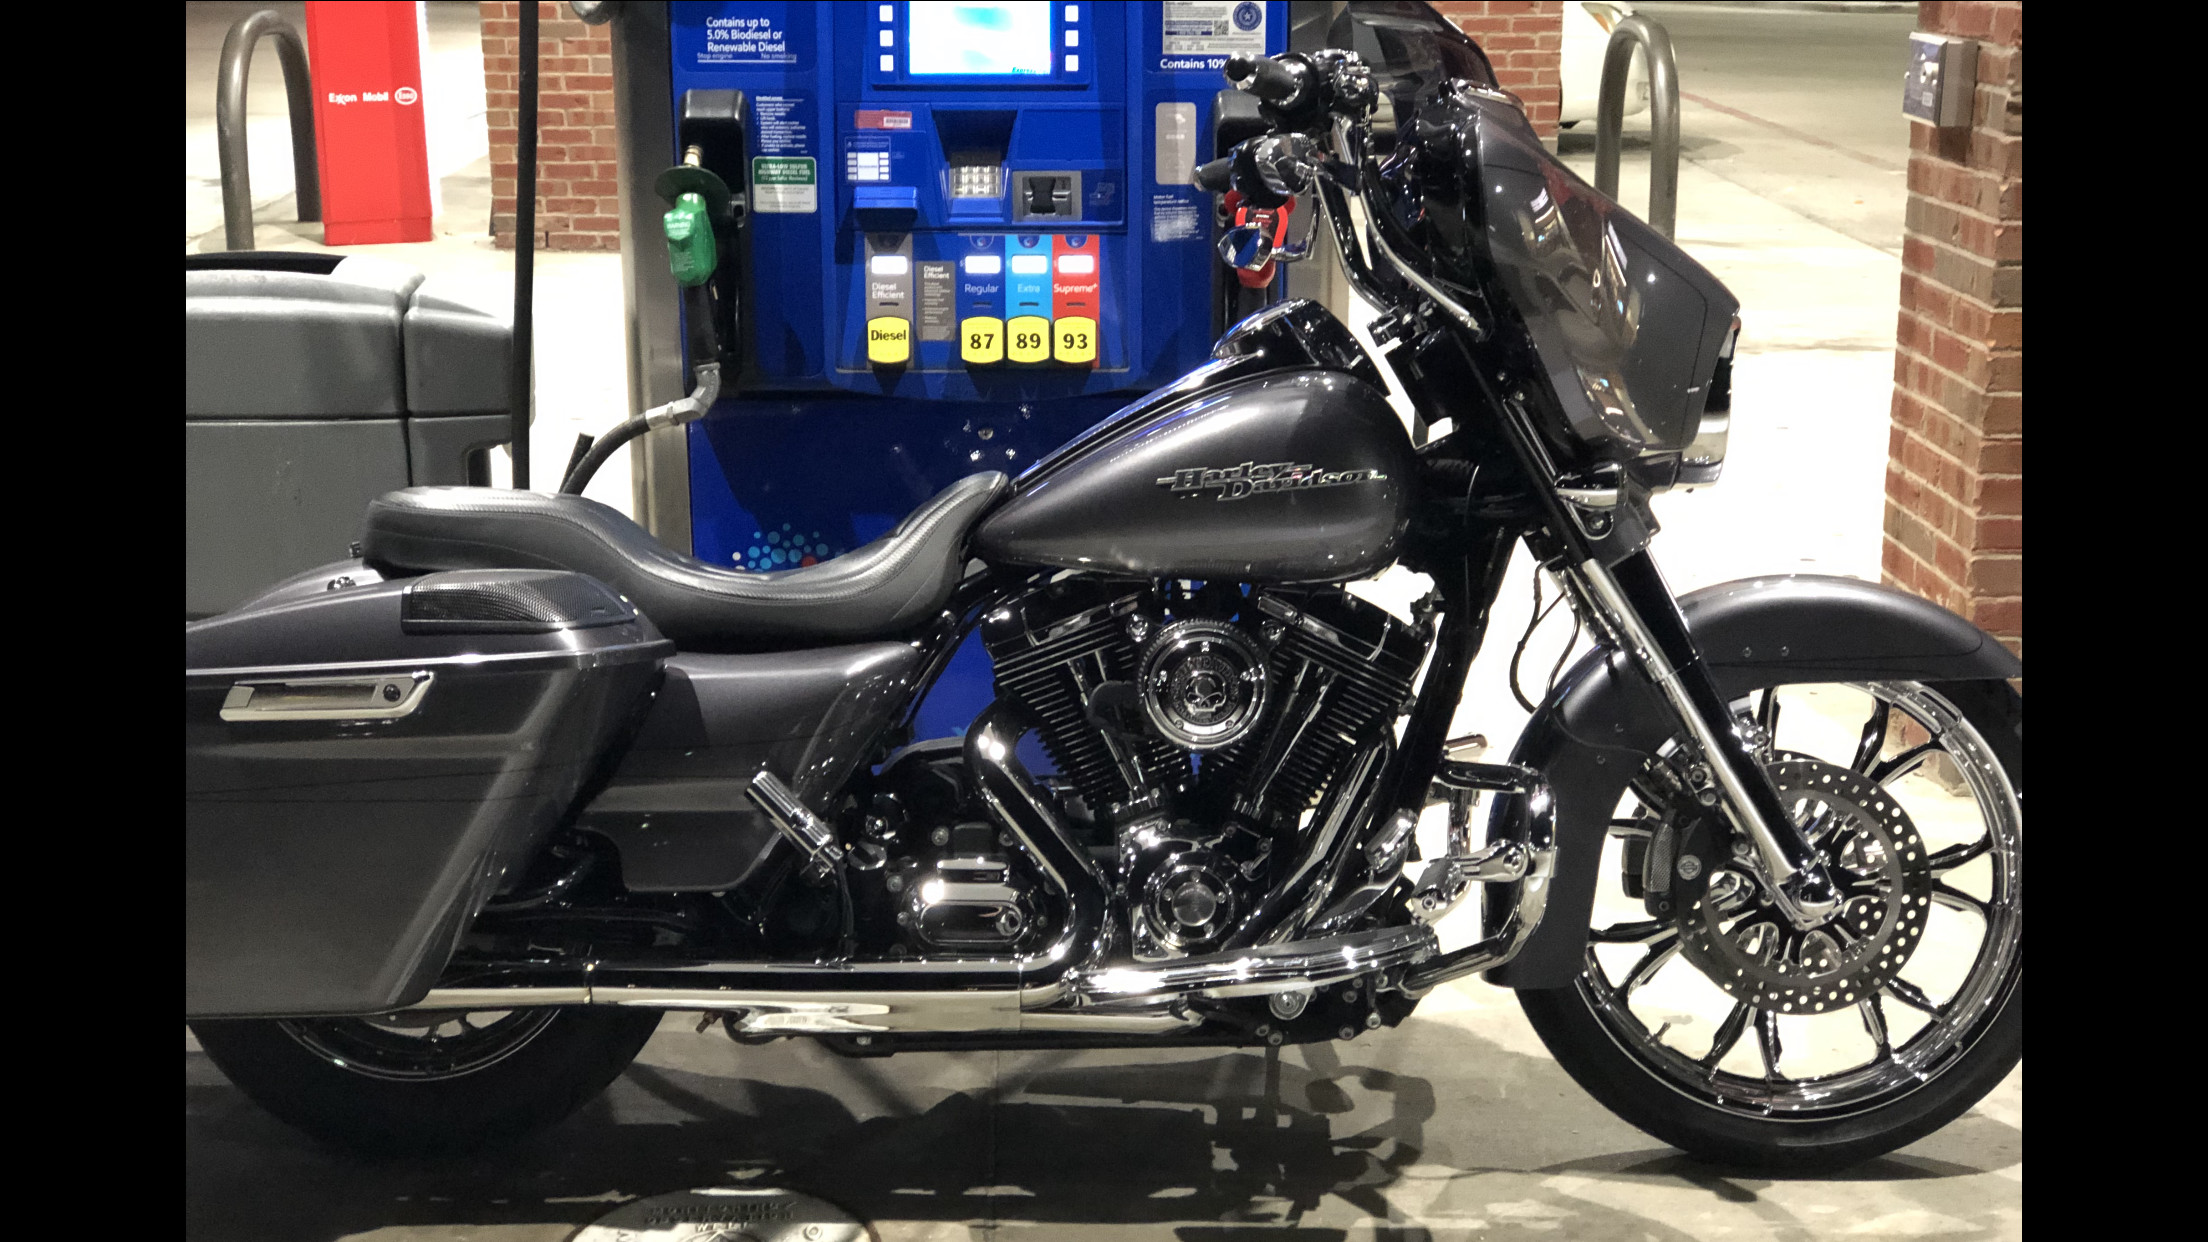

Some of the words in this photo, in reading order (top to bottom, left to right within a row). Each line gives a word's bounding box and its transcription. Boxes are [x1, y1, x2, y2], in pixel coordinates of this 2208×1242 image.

[706, 16, 745, 28] Contains
[746, 18, 759, 29] up
[760, 17, 770, 28] to
[707, 29, 729, 40] 5.0%
[731, 28, 771, 40] Biodiesel
[772, 31, 783, 40] or
[707, 41, 756, 52] Renewable
[758, 40, 786, 52] Diesel
[1160, 58, 1205, 69] Contains
[328, 93, 357, 105] Exxon
[362, 91, 389, 101] Mobil
[872, 282, 897, 290] Diesel
[964, 283, 999, 296] Regular
[1017, 283, 1041, 294] Extra
[872, 291, 905, 299] Efficient
[870, 329, 907, 342] Diesel
[970, 333, 995, 350] 87
[1016, 332, 1041, 350] 89
[1063, 332, 1088, 350] 93
[1214, 468, 1387, 501] Davidson
